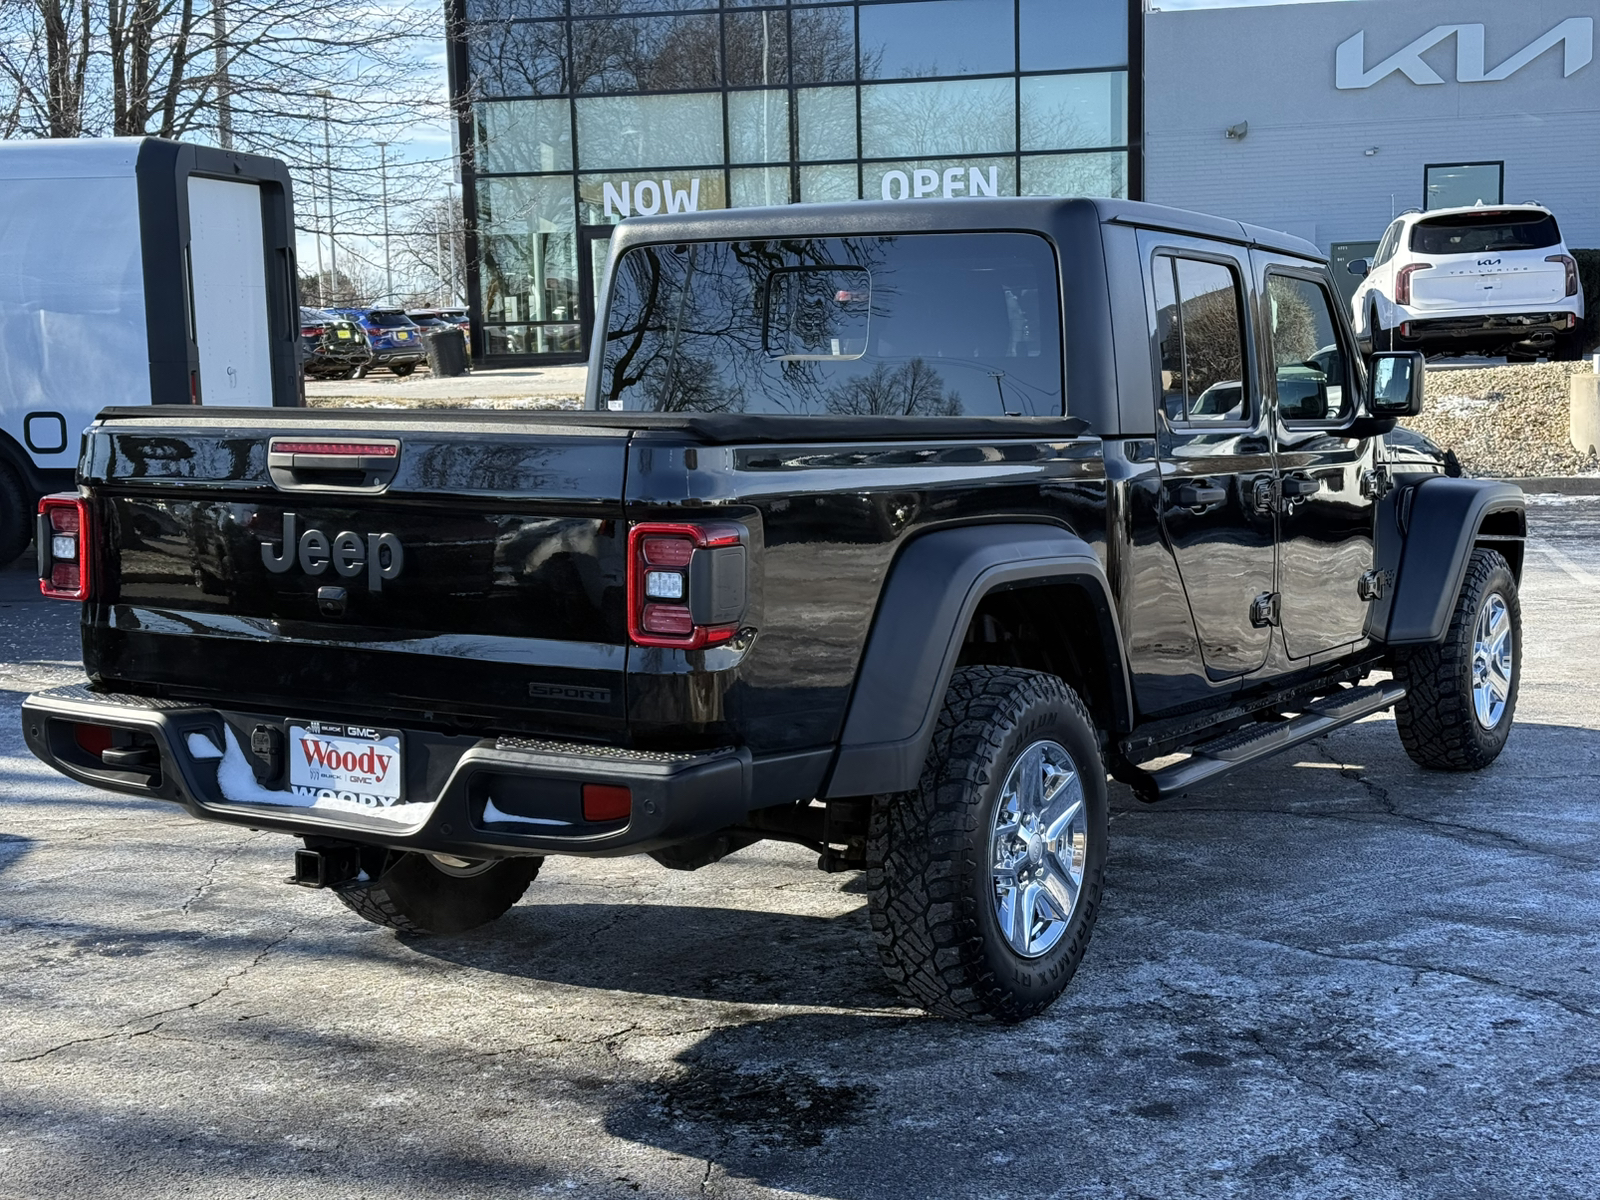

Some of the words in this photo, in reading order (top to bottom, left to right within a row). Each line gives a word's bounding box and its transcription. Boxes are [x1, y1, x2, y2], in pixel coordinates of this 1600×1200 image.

[1335, 17, 1593, 89] KIA
[603, 178, 700, 217] NOW
[881, 166, 998, 200] OPEN
[1450, 267, 1528, 275] TELLURIDE
[261, 512, 404, 592] Jeep
[530, 685, 611, 700] SPORT
[347, 726, 375, 738] GMC
[299, 738, 393, 783] Woody
[349, 775, 372, 785] GMC
